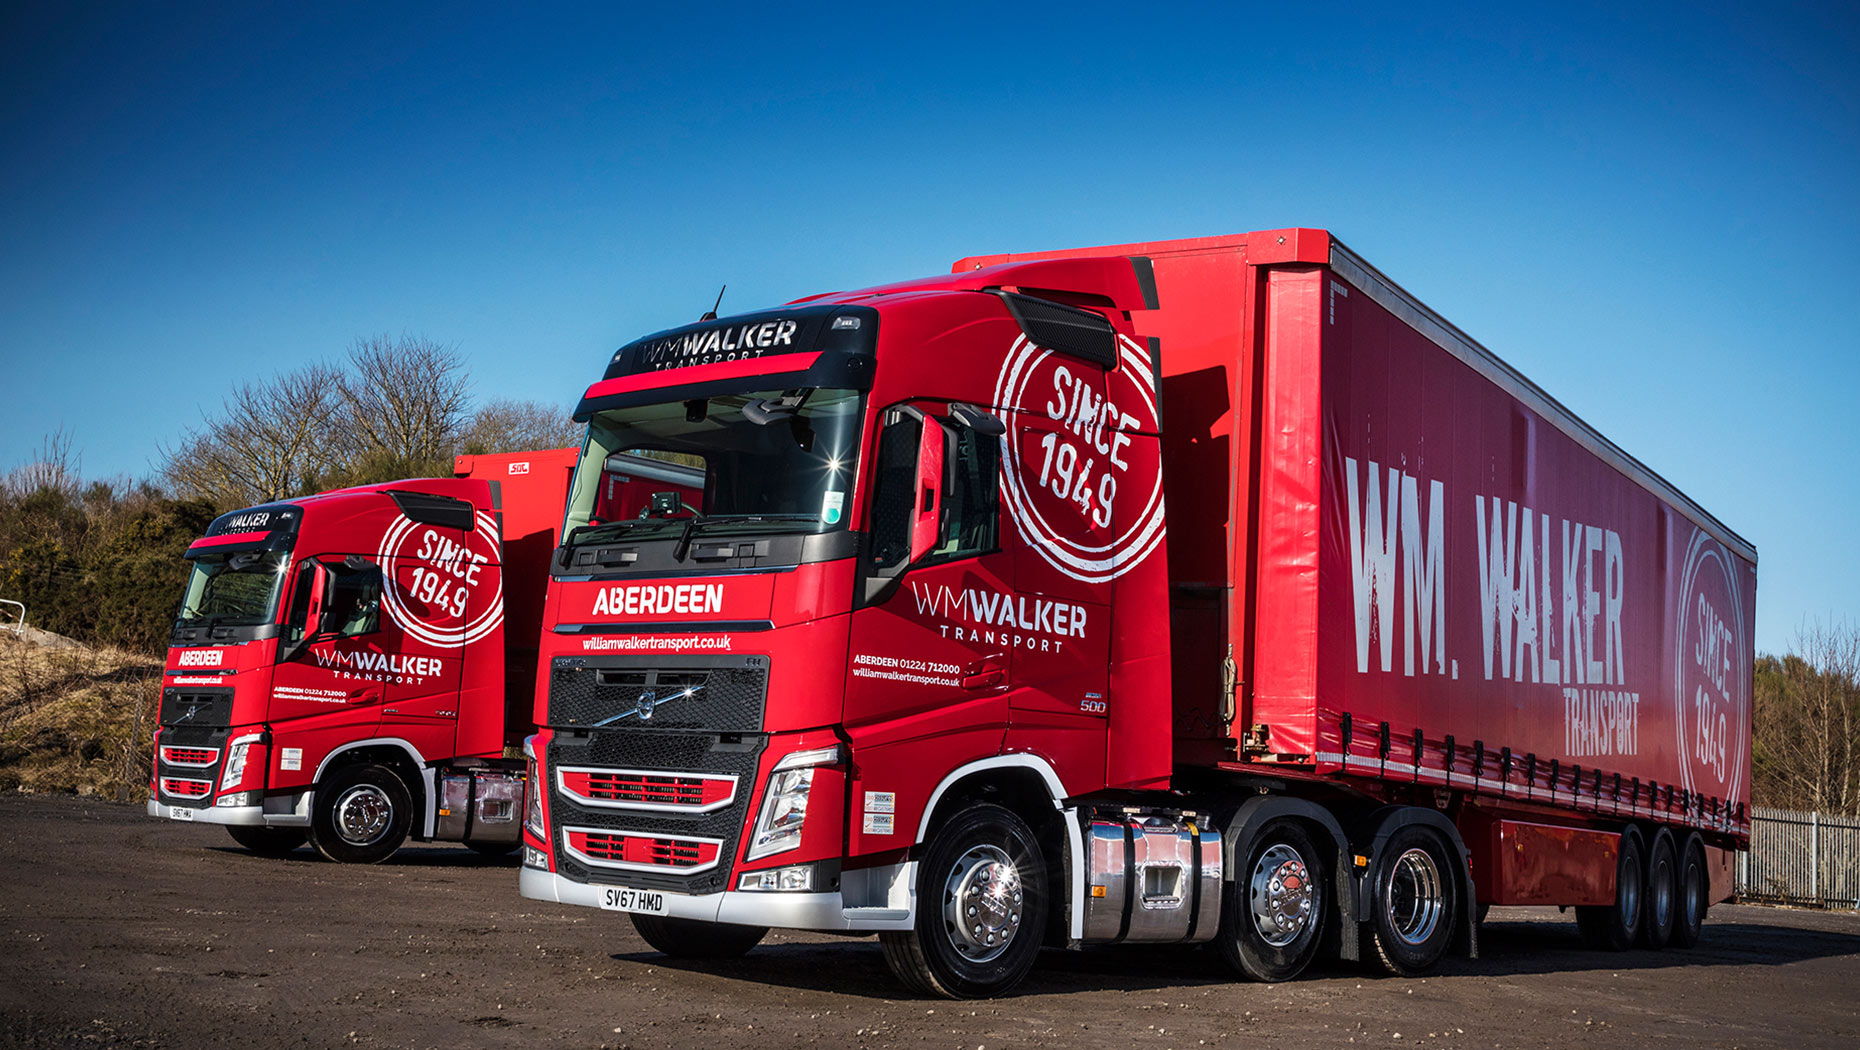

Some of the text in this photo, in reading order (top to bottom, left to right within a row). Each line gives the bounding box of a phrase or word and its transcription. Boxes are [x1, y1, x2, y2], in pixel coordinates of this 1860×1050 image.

[655, 350, 764, 372] TRANSPORT
[1046, 366, 1141, 472] SINCE
[1039, 432, 1117, 529] 1949
[417, 529, 489, 587] SINCE
[1345, 456, 1625, 686] WM. WALKER
[410, 567, 469, 618] 1949
[592, 584, 724, 616] ABERDEEN
[582, 635, 732, 652] williamwalkertransport.co.uk
[940, 625, 1063, 654] TRANSPORT
[1695, 592, 1733, 703] SINCE
[178, 650, 224, 667] ABERDEEN
[853, 654, 960, 675] ABERDEEN 01224 712000
[274, 686, 304, 694] ABERDEEN
[333, 670, 423, 685] TRANSPORT
[852, 667, 960, 687] williamwalkertransport.co.uk
[1080, 699, 1106, 713] 500
[1562, 687, 1640, 757] TRANSPORT
[1695, 683, 1727, 784] 1949
[606, 889, 663, 911] SV67 HMD
